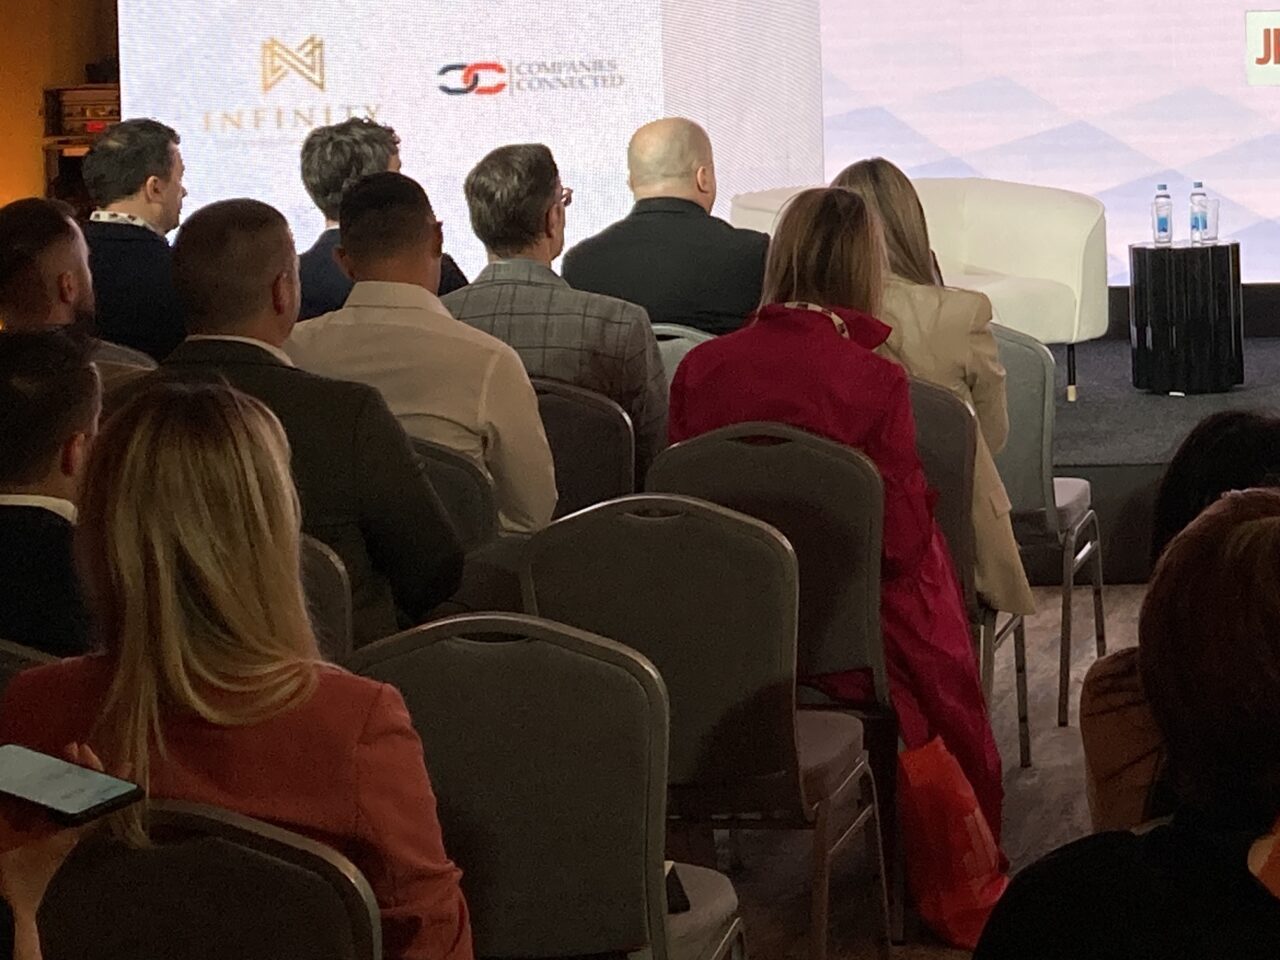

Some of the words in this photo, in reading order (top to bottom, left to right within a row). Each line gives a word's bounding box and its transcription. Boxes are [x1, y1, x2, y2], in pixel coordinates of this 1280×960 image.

[515, 59, 617, 76] COMPANIES
[515, 74, 625, 91] CONNECTED
[203, 103, 382, 132] INFINITY
